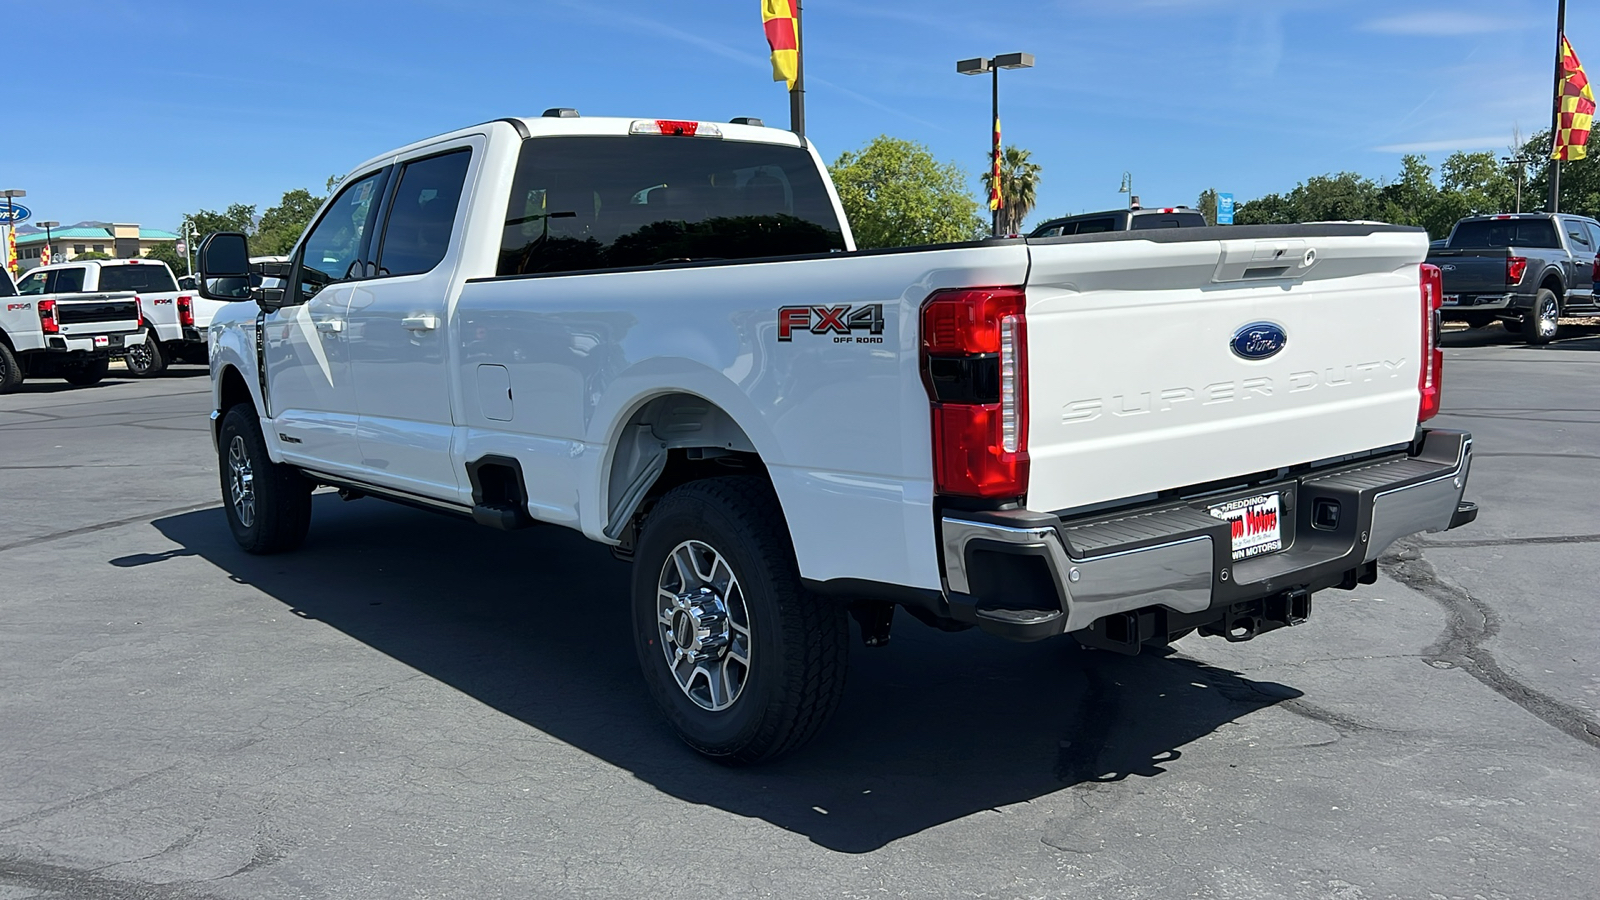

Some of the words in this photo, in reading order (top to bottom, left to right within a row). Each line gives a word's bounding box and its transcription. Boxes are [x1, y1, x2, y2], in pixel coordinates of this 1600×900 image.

[8, 302, 31, 311] FX4
[778, 304, 884, 342] FX4
[1246, 330, 1277, 353] Ford
[1062, 376, 1273, 425] SUPER
[1289, 358, 1406, 394] DUTY
[1227, 496, 1263, 511] REDDING
[1246, 505, 1277, 536] Motors
[1246, 541, 1278, 556] MOTORS
